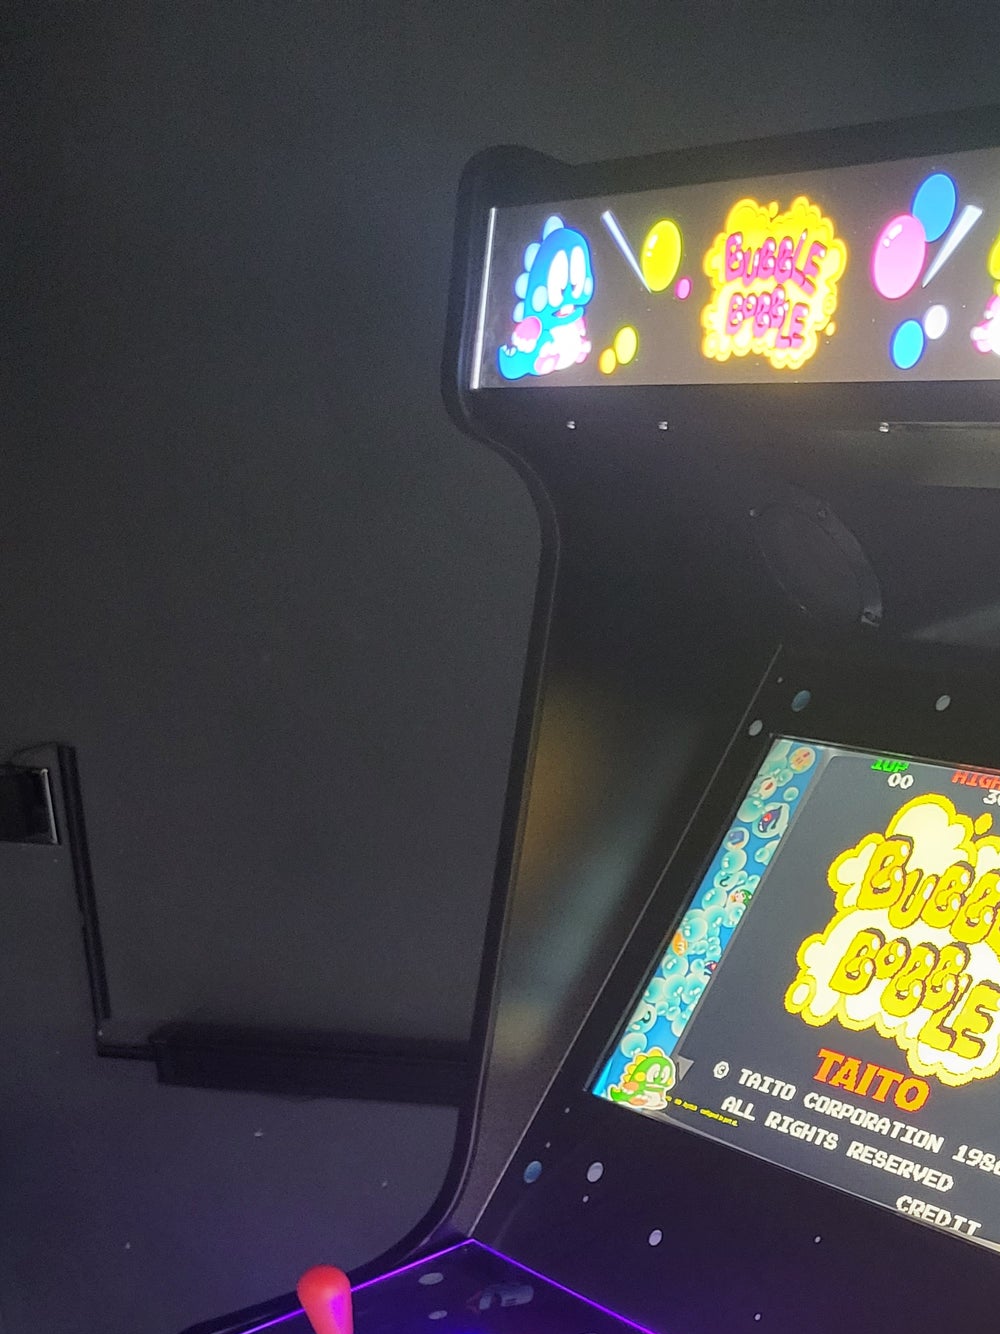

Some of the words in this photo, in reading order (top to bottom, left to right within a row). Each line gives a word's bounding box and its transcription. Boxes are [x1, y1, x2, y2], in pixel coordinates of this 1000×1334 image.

[725, 228, 827, 296] BUBBLE
[887, 772, 914, 790] 00
[738, 1068, 796, 1101] TAITO
[803, 1091, 944, 1153] CORPORATION
[813, 1048, 931, 1112] TAITO
[721, 1096, 755, 1121] ALL
[764, 1111, 839, 1150] RIGHTS
[846, 1141, 954, 1192] RESERVED
[896, 1194, 982, 1236] CREDIT
